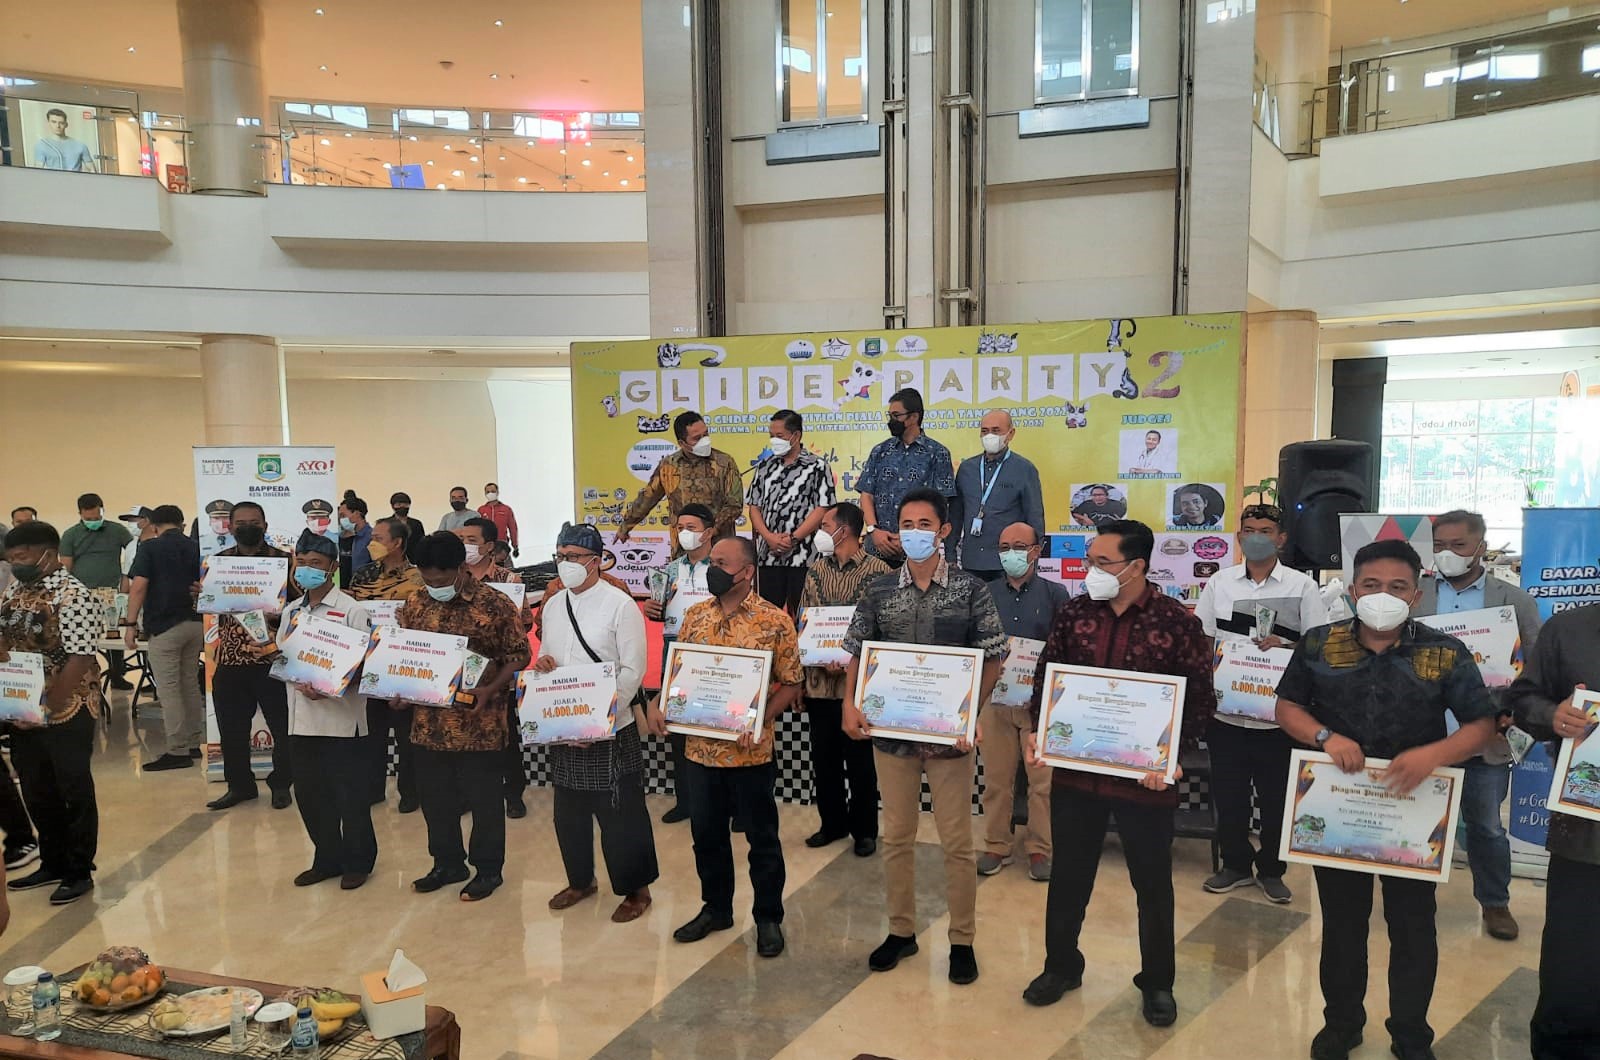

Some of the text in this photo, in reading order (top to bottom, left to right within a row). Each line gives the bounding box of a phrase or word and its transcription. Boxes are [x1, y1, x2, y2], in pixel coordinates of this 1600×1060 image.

[625, 351, 1184, 403] GLIDE PARTY 2
[716, 413, 757, 424] GLIDER
[847, 411, 883, 422] PIALA
[1039, 405, 1067, 417] 2022
[202, 463, 235, 474] LIVE
[1542, 566, 1596, 580] BAYAR
[542, 704, 596, 719] 14.000.000,-
